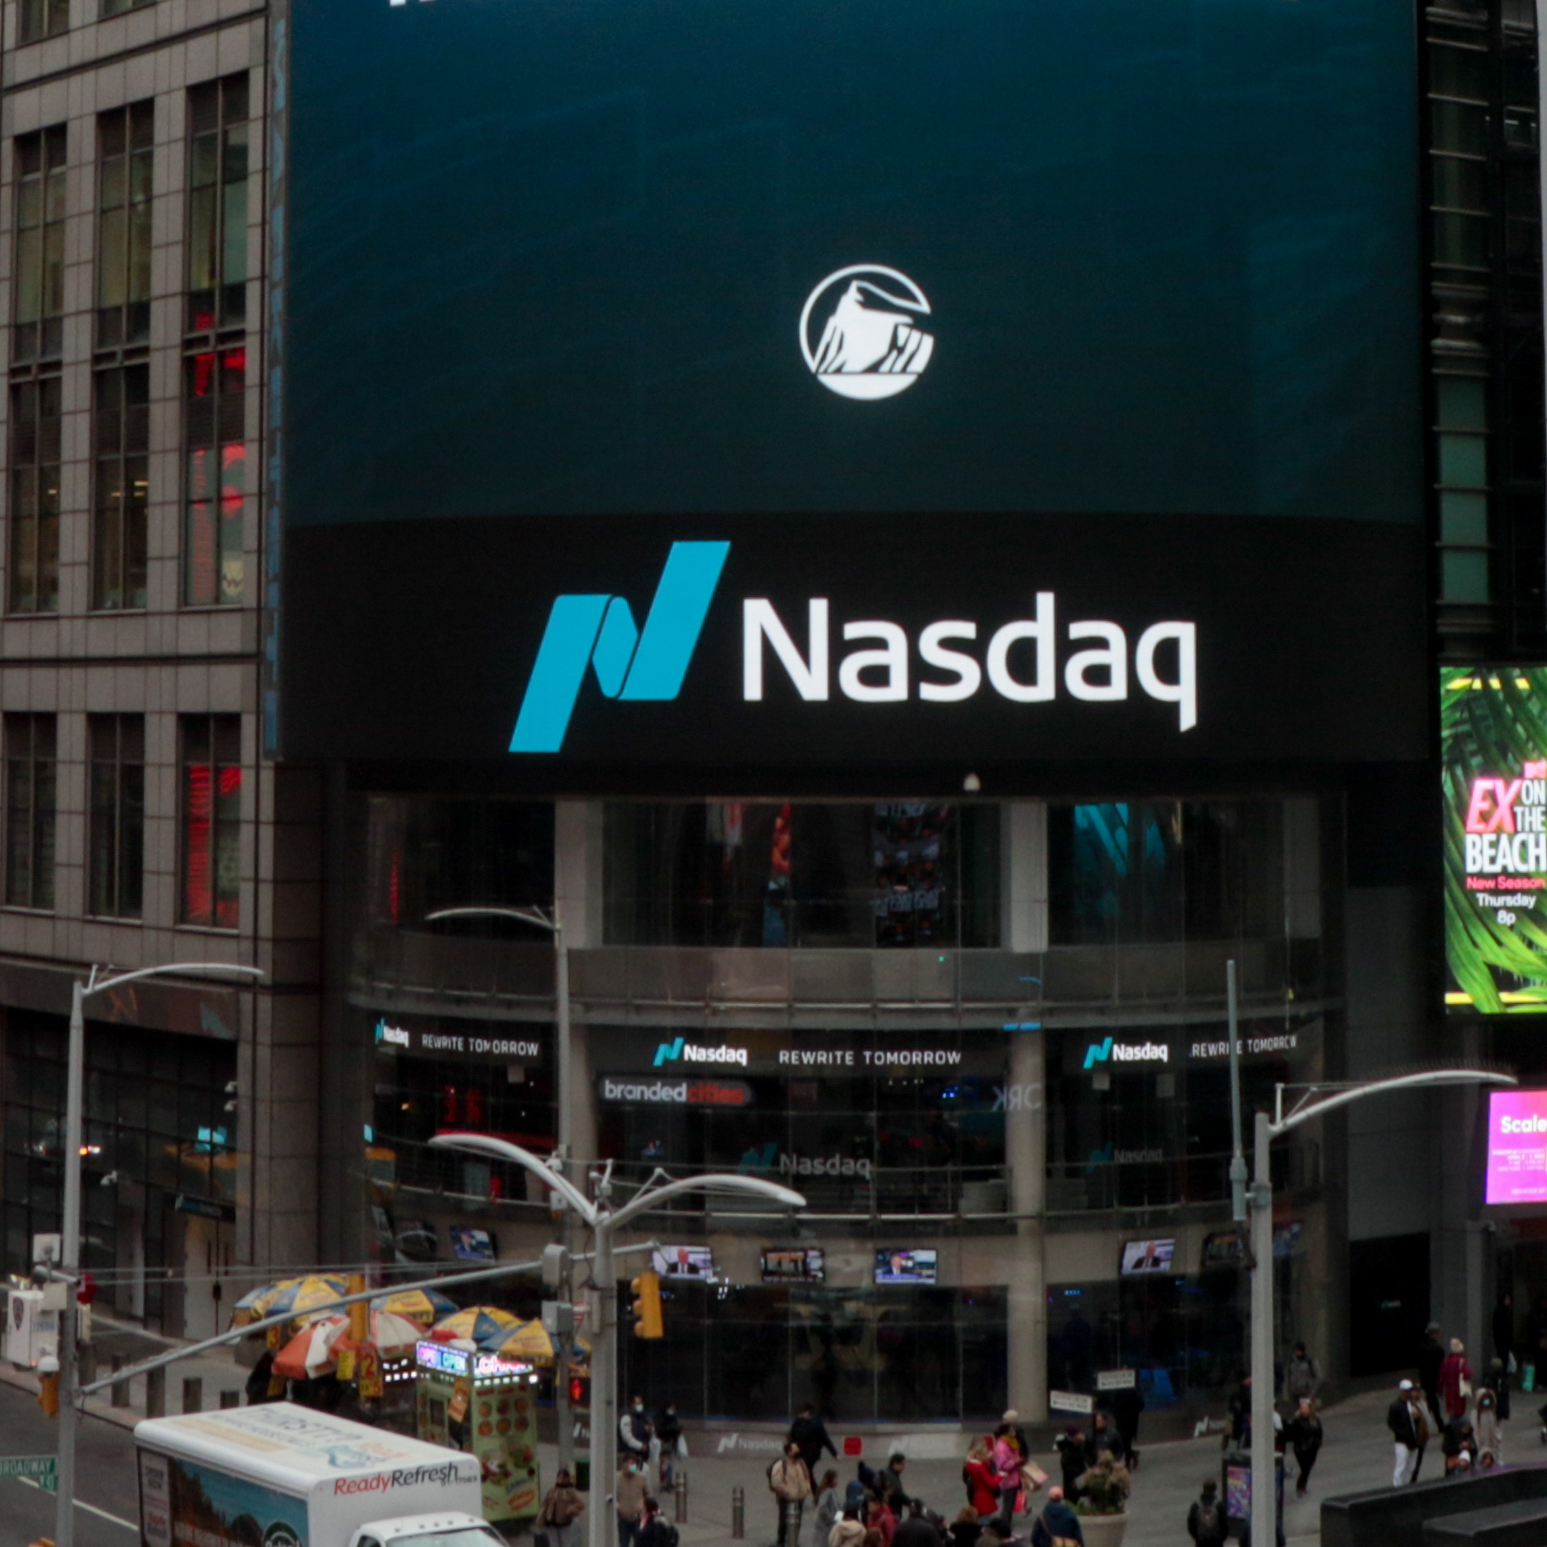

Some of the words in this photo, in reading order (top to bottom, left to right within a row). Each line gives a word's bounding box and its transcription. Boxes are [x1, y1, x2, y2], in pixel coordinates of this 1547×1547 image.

[742, 592, 1198, 733] Nasdaq
[1520, 780, 1546, 805] ON
[1466, 779, 1521, 833] EX
[1513, 805, 1546, 833] THE
[1465, 833, 1547, 874] BEACH
[1466, 877, 1496, 891] New
[1497, 876, 1547, 891] Season
[1476, 893, 1537, 911] Thursday
[1497, 910, 1516, 927] 8p
[383, 1026, 410, 1049] Nasdaq
[421, 1033, 464, 1052] REWRITE
[468, 1036, 539, 1057] TOMORROW
[1191, 1039, 1243, 1058] REWRIE
[683, 1044, 748, 1067] Nasdaq
[778, 1050, 854, 1066] REWRITE
[863, 1050, 962, 1066] TOMORROW
[1112, 1041, 1169, 1063] Nasdaq
[780, 1153, 871, 1180] Nasdaq
[333, 1462, 459, 1495] ReadyRefresh
